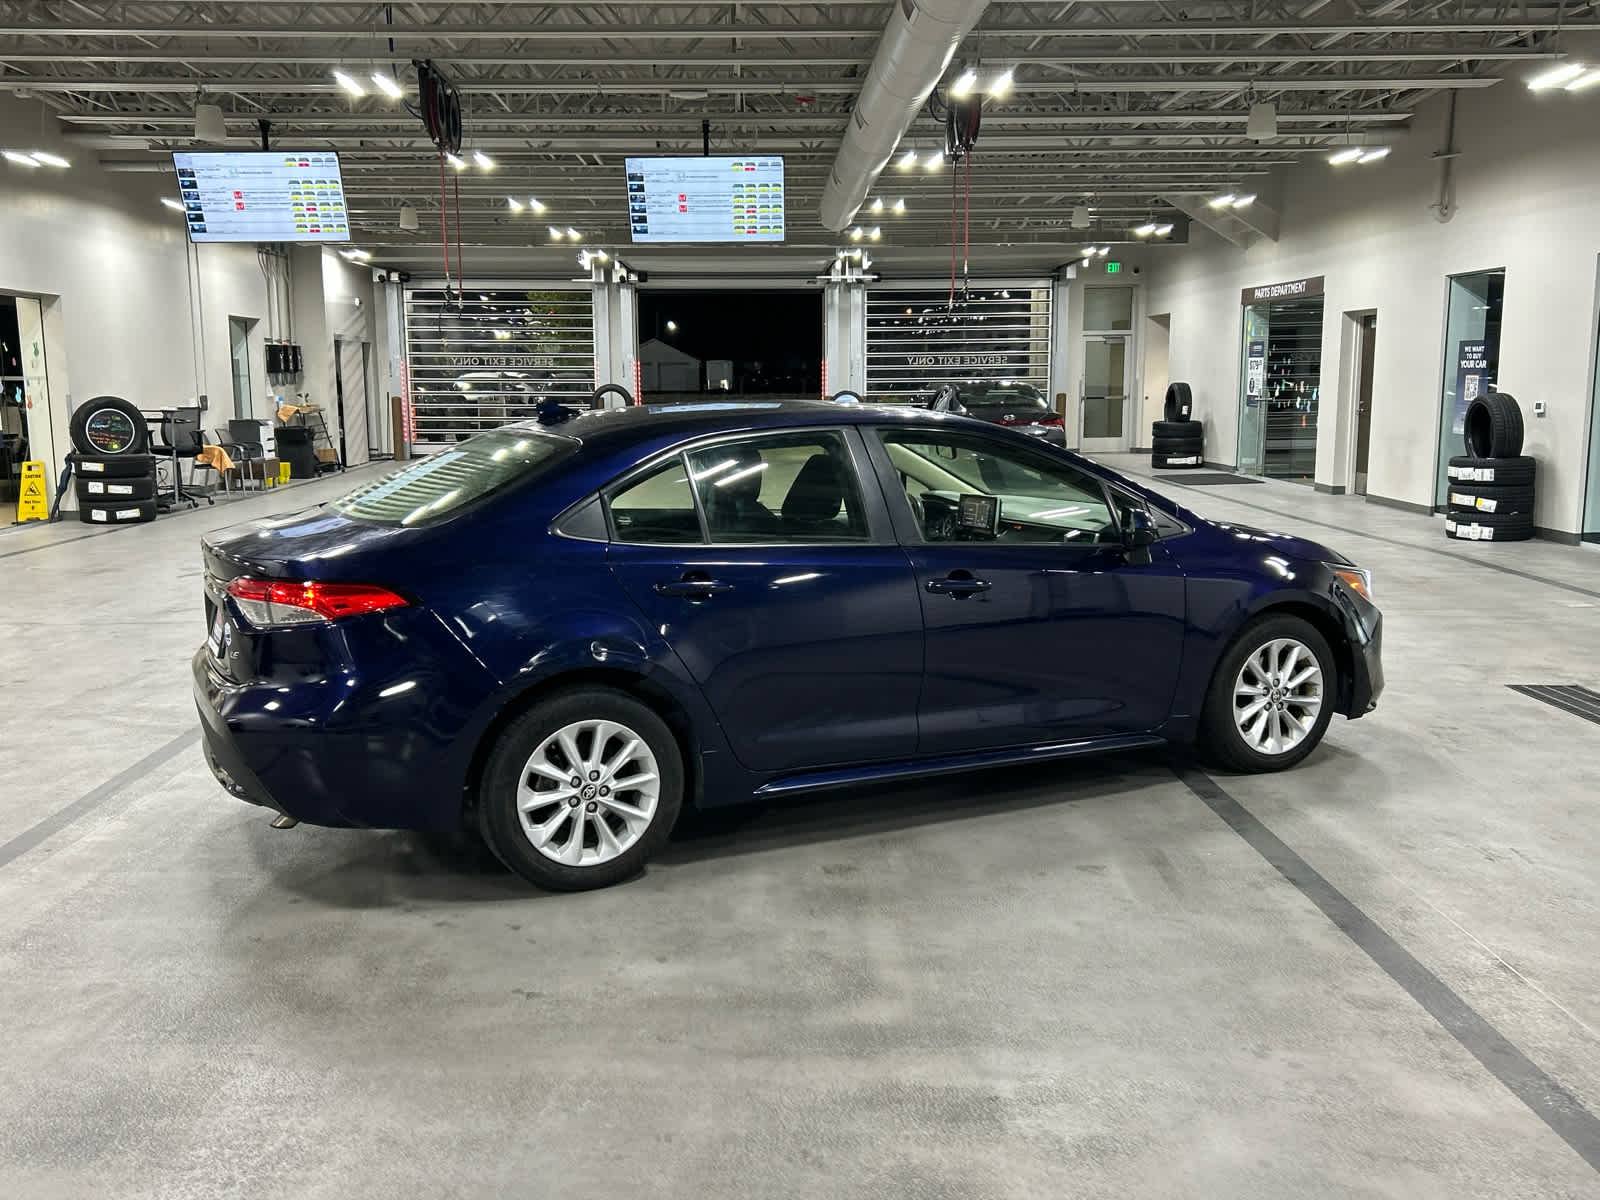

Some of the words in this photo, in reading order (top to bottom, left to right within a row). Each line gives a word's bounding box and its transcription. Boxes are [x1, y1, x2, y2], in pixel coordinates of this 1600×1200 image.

[1107, 262, 1120, 272] EXIT
[1254, 288, 1270, 299] PARTS
[1270, 281, 1307, 297] DEPARTMENT
[1460, 360, 1475, 368] YOUR
[1475, 360, 1487, 369] CAR
